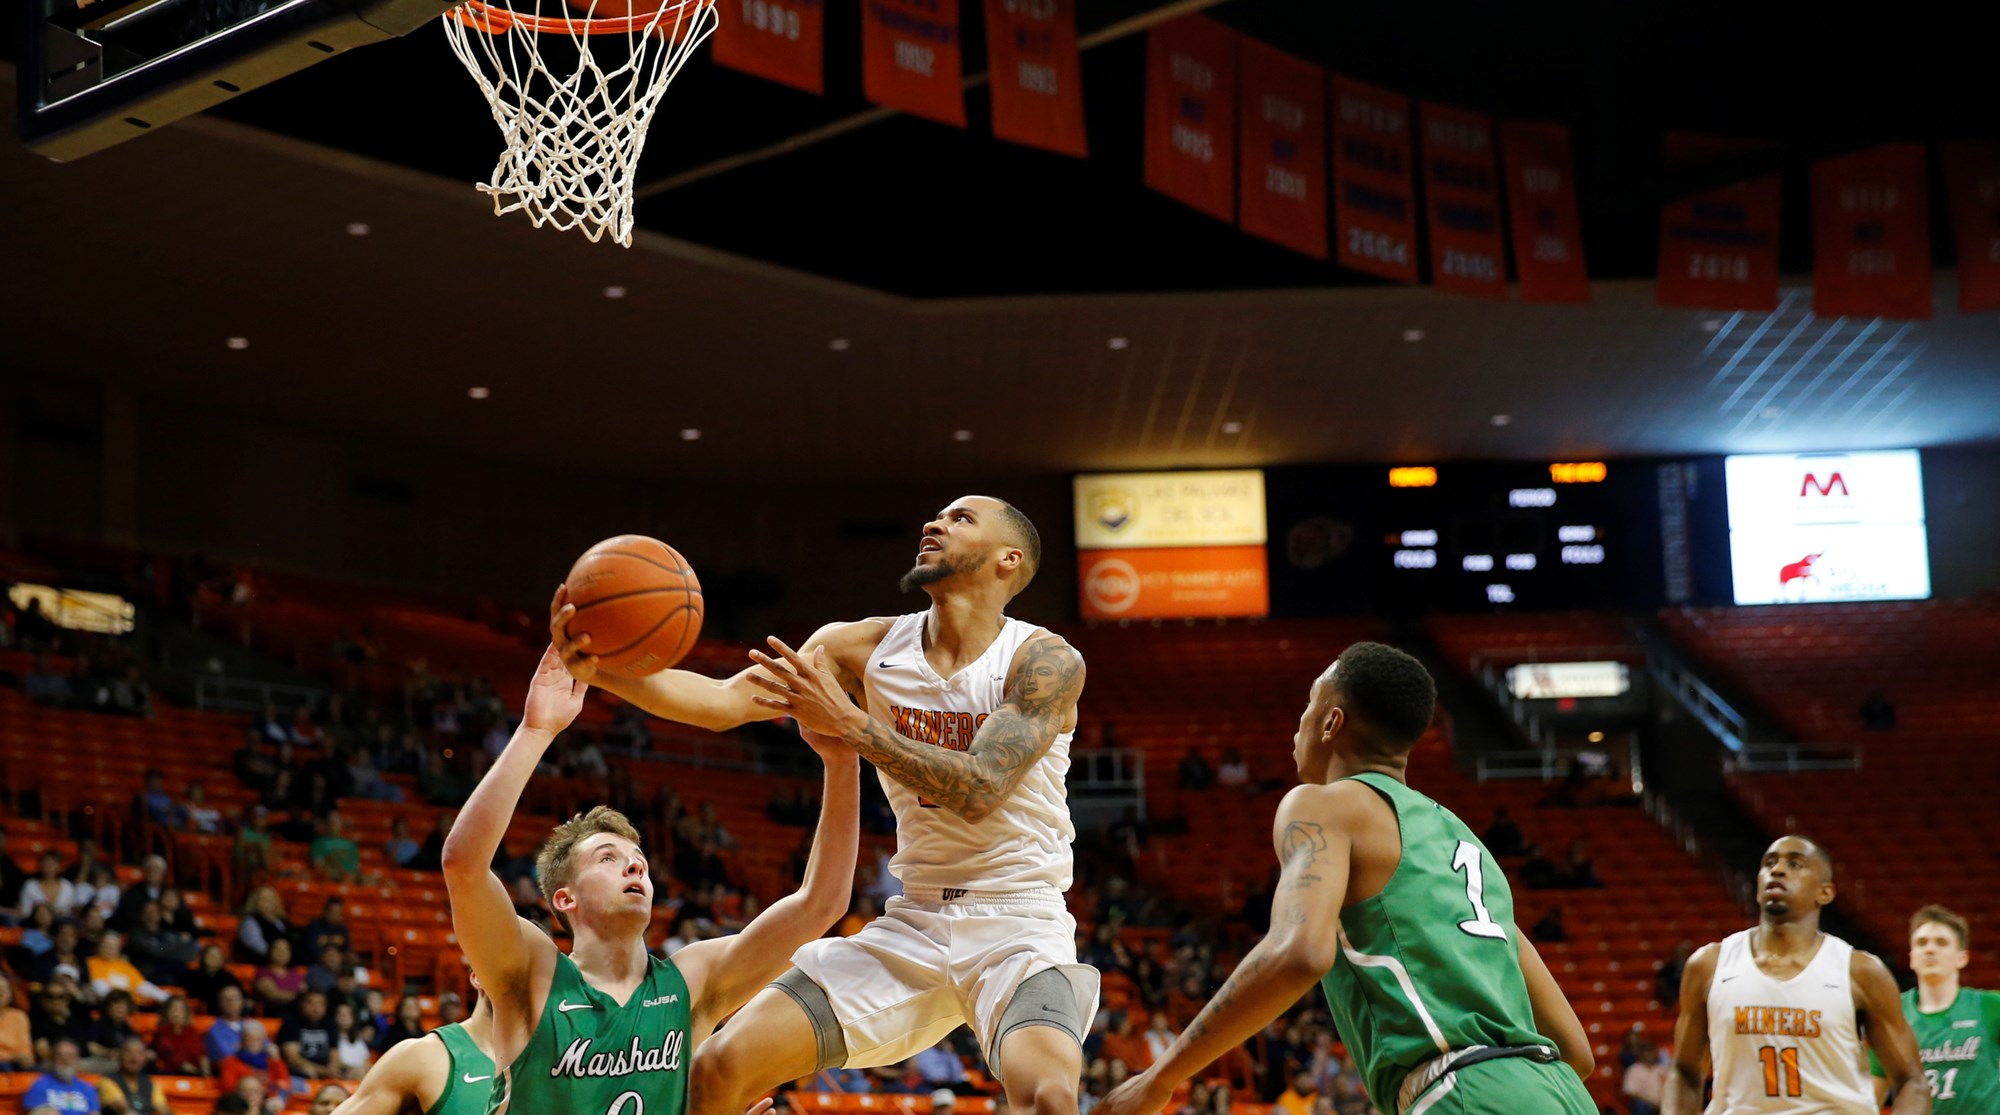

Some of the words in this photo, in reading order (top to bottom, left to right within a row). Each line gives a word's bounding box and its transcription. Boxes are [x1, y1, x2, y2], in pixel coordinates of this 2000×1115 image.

[742, 0, 799, 41] 1990
[1348, 226, 1408, 267] 2004
[1688, 252, 1750, 283] 2010
[1451, 839, 1508, 944] 1
[1734, 1005, 1822, 1038] MINERS
[550, 1028, 684, 1077] Marshall
[1759, 1045, 1802, 1097] 11
